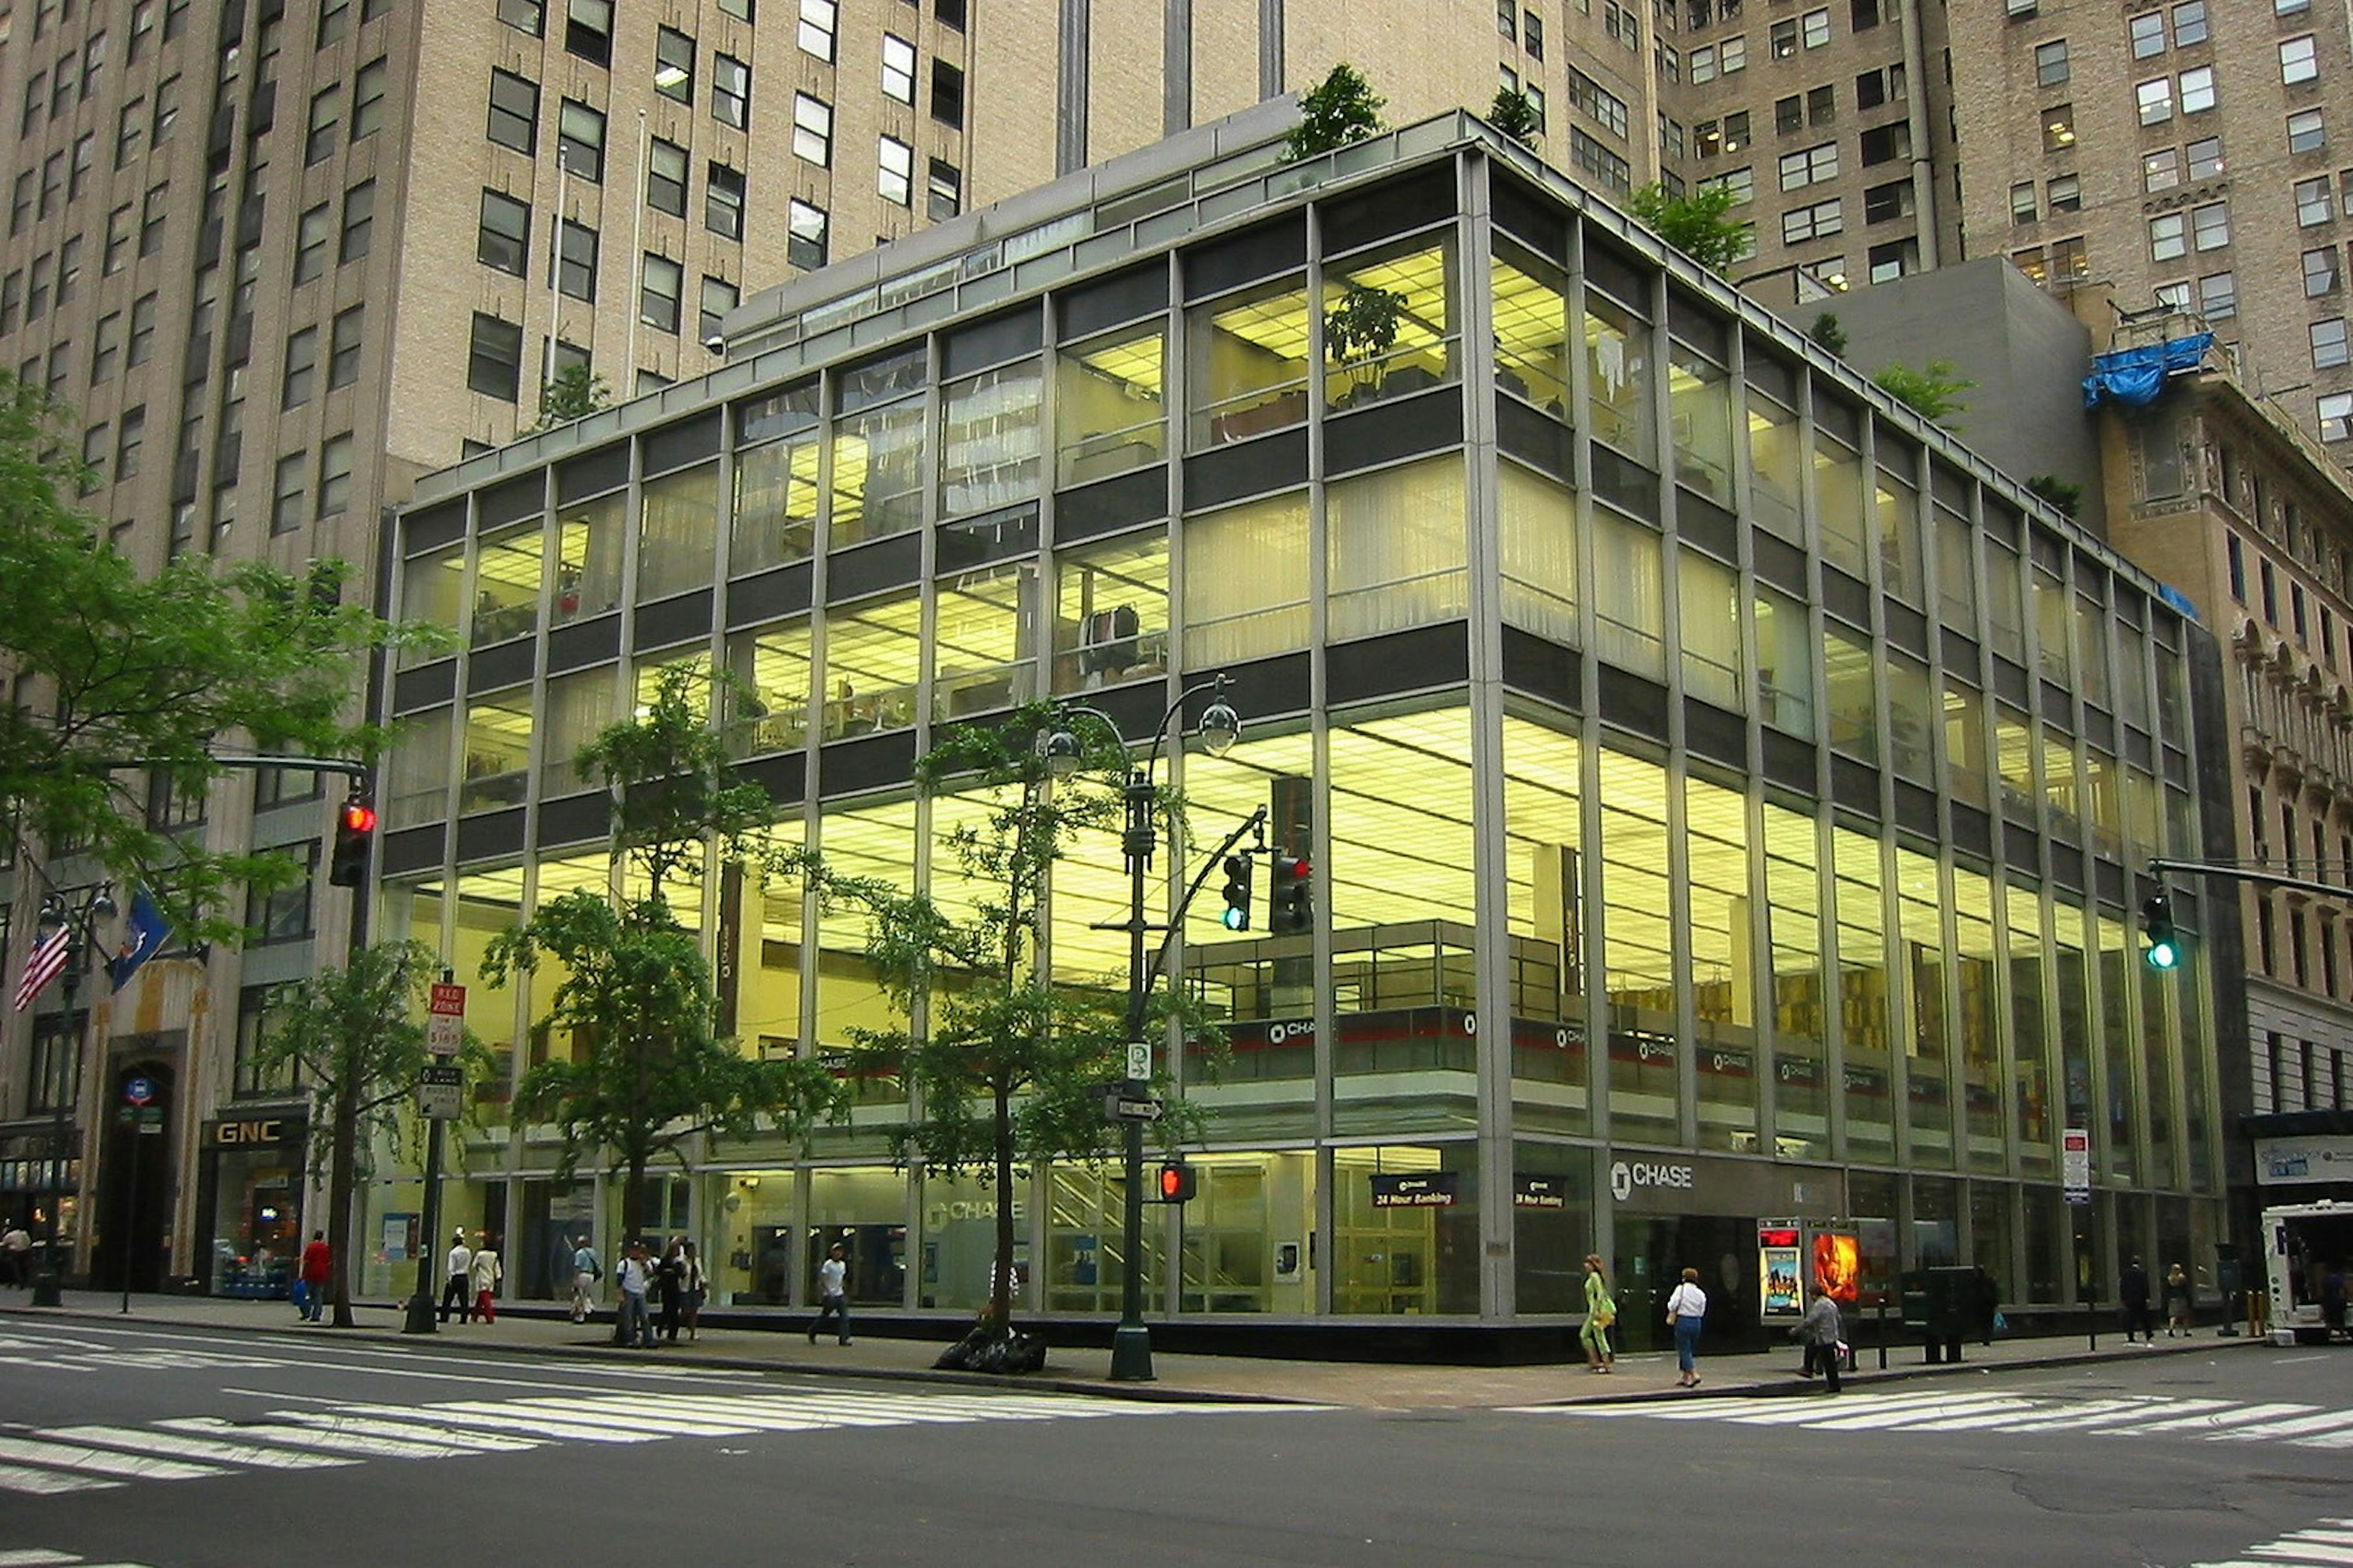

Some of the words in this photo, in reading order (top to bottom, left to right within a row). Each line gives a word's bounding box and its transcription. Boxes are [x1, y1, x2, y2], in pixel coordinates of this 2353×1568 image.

[433, 1000, 461, 1013] ZONE
[1287, 1022, 1315, 1035] CHA
[217, 1120, 281, 1144] GNC
[1633, 1162, 1693, 1188] CHASE
[1390, 1194, 1413, 1204] Hour
[1414, 1192, 1452, 1205] Banking
[951, 1201, 1024, 1219] CHAE
